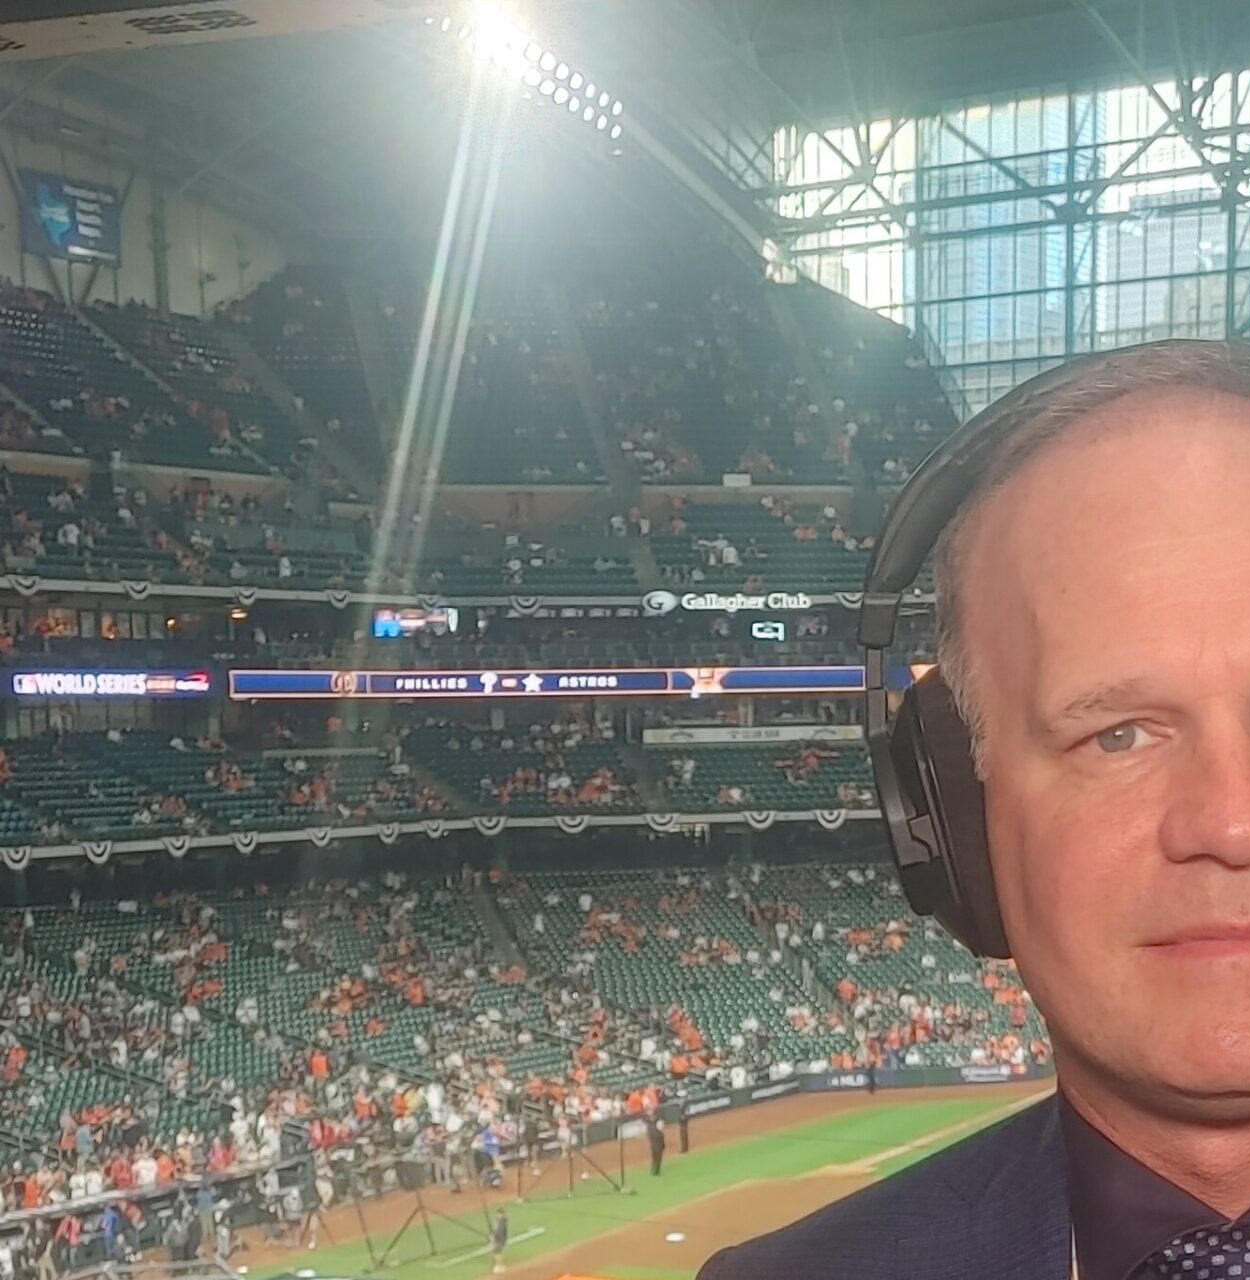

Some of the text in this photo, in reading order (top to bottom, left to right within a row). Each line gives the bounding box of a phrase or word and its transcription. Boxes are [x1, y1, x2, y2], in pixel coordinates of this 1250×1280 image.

[681, 593, 763, 611] Gallagher
[767, 592, 812, 609] Club
[37, 673, 97, 695] WORLD
[97, 673, 148, 694] SERIES
[558, 675, 618, 688] ASTROS
